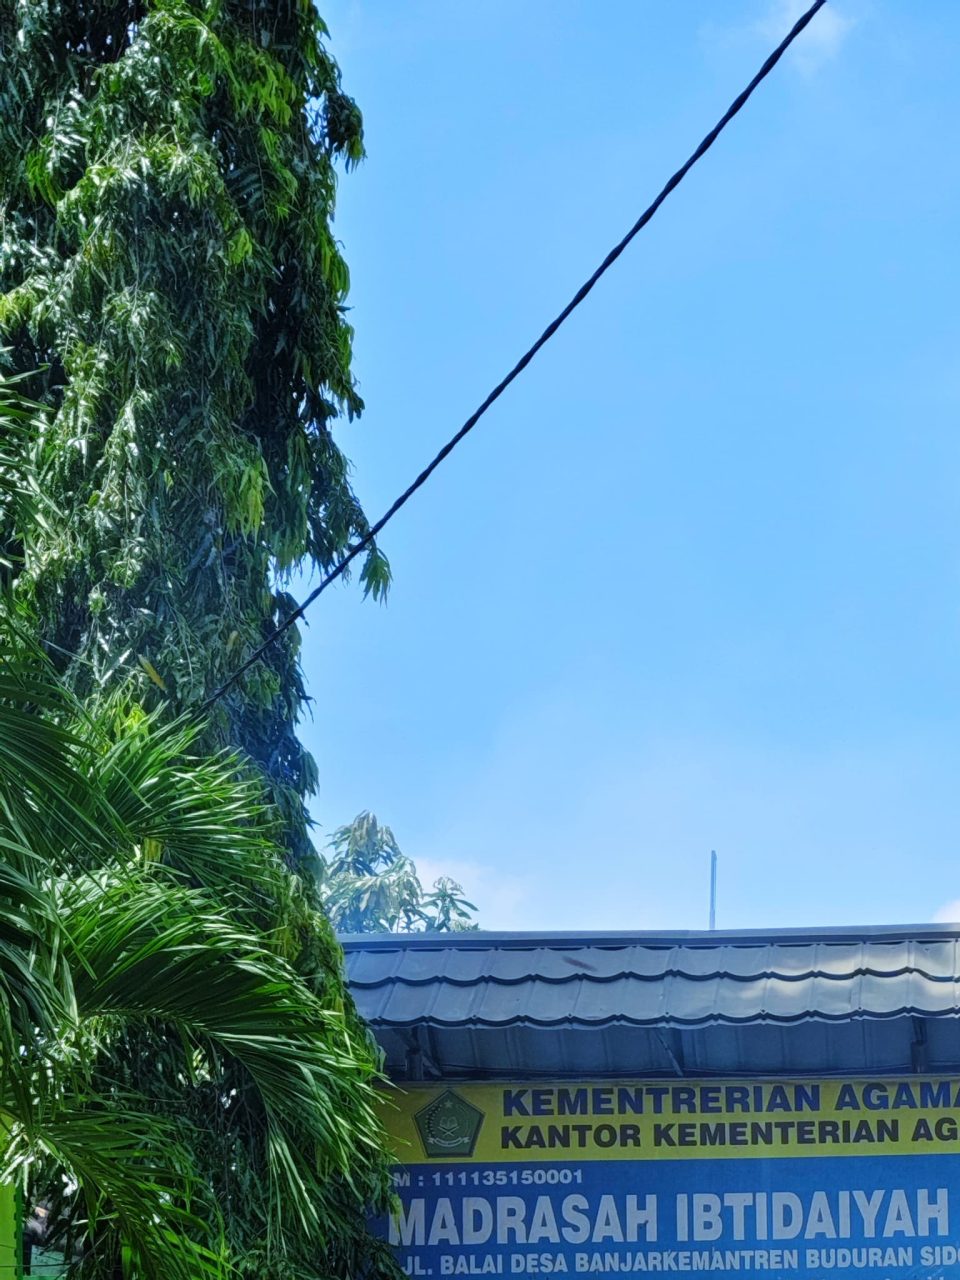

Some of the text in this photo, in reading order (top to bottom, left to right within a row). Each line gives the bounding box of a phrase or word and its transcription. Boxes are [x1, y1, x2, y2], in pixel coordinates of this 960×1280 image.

[503, 1084, 820, 1116] KEMENTRERIAN
[502, 1124, 640, 1149] KANTOR
[654, 1119, 898, 1146] KEMENTERIAN
[432, 1169, 583, 1186] 111135150001
[388, 1193, 657, 1246] MADRASAH
[676, 1188, 949, 1242] IBTIDAIYAH
[440, 1254, 503, 1274] BALAI
[510, 1253, 568, 1273] DESA
[575, 1249, 798, 1274] BANJARKEMANTREN
[806, 1247, 913, 1269] BUDURAN
